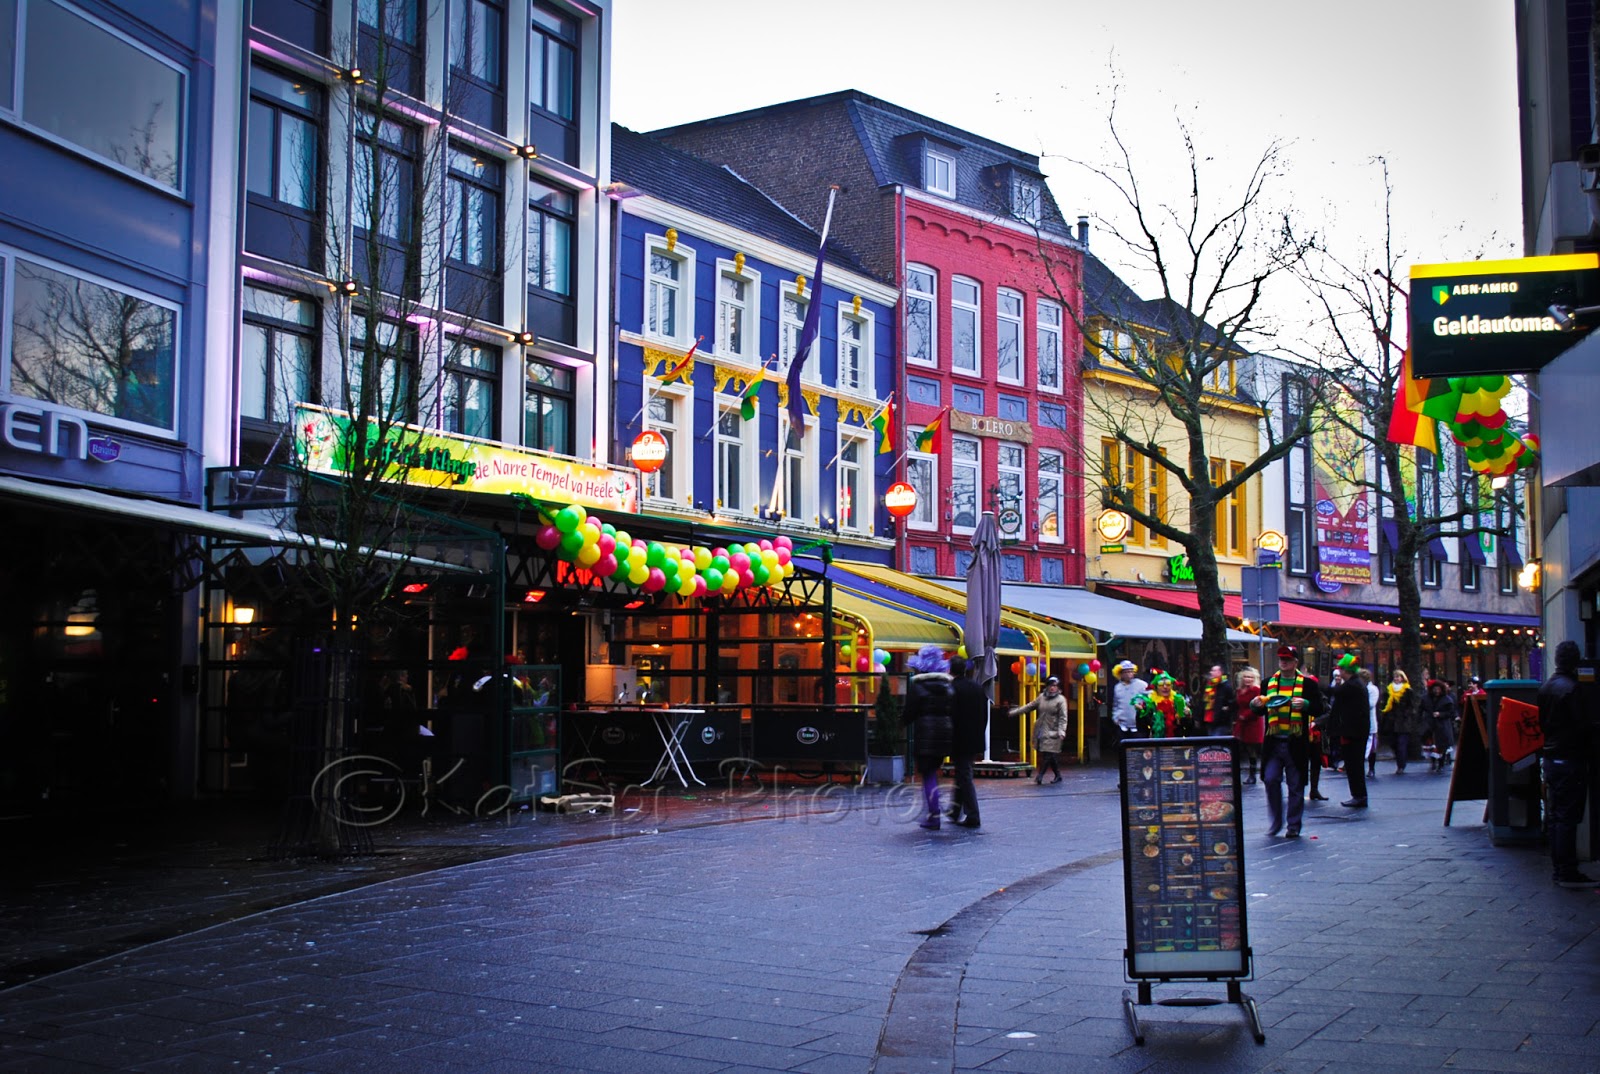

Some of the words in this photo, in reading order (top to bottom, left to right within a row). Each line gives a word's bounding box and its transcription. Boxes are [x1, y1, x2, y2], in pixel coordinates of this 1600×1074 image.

[1433, 314, 1562, 336] Geldautoma
[971, 417, 1013, 436] BOLERO
[475, 461, 490, 480] de
[493, 459, 528, 478] Narre
[530, 462, 570, 490] Tempel
[571, 480, 583, 494] va
[586, 481, 614, 499] Heële
